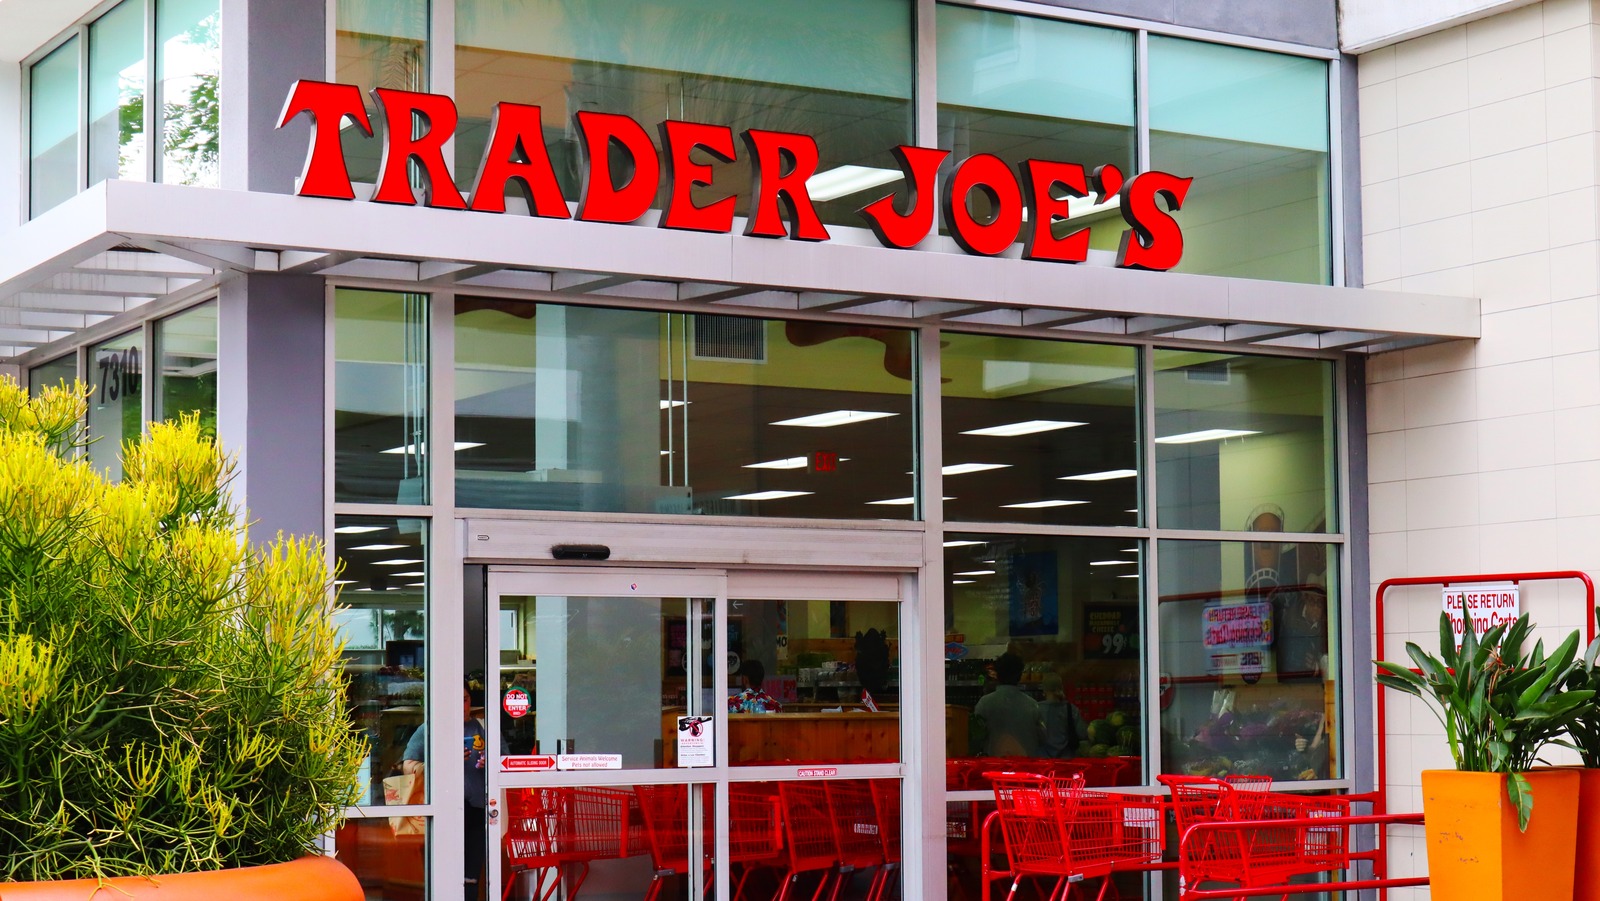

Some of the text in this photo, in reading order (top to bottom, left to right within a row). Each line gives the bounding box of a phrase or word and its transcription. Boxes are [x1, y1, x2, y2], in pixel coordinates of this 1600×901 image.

[276, 80, 1193, 271] TRADER JOE'S
[99, 345, 138, 404] 7310
[815, 451, 837, 471] EXIT
[1447, 593, 1515, 609] PLESE RETURN
